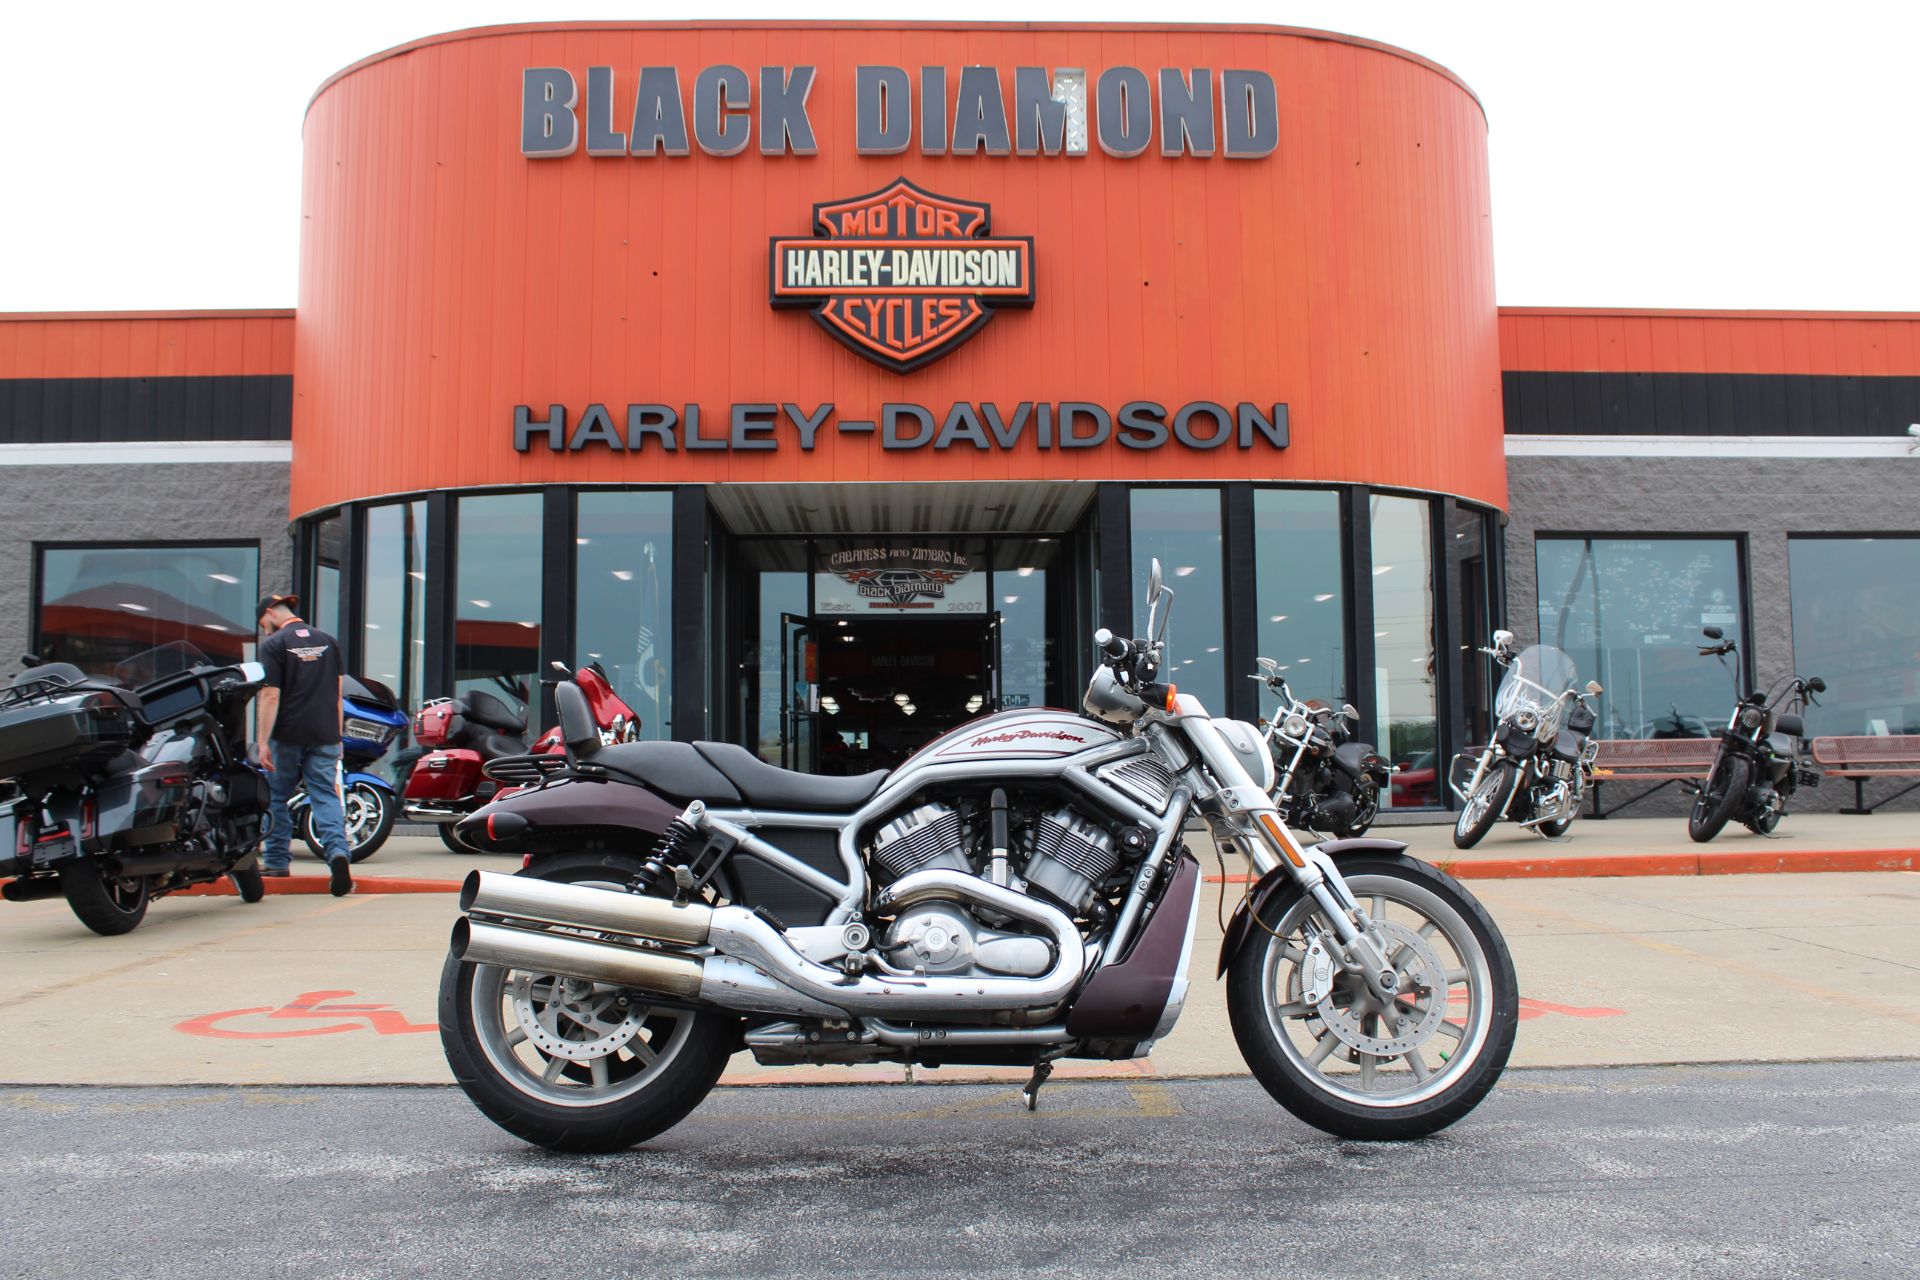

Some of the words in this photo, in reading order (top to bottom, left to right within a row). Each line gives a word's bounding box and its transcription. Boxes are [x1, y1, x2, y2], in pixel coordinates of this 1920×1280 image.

[521, 65, 818, 160] BLACK
[855, 65, 1279, 160] DIAMOND
[841, 193, 963, 237] MOTOR
[787, 249, 1018, 287] HARLEY-DAVIDSON
[842, 298, 962, 350] CYCLES
[513, 401, 1290, 453] HARLEY-DAVIDSON
[954, 552, 968, 566] Inc.
[821, 602, 856, 612] Est.
[947, 601, 983, 612] 2007
